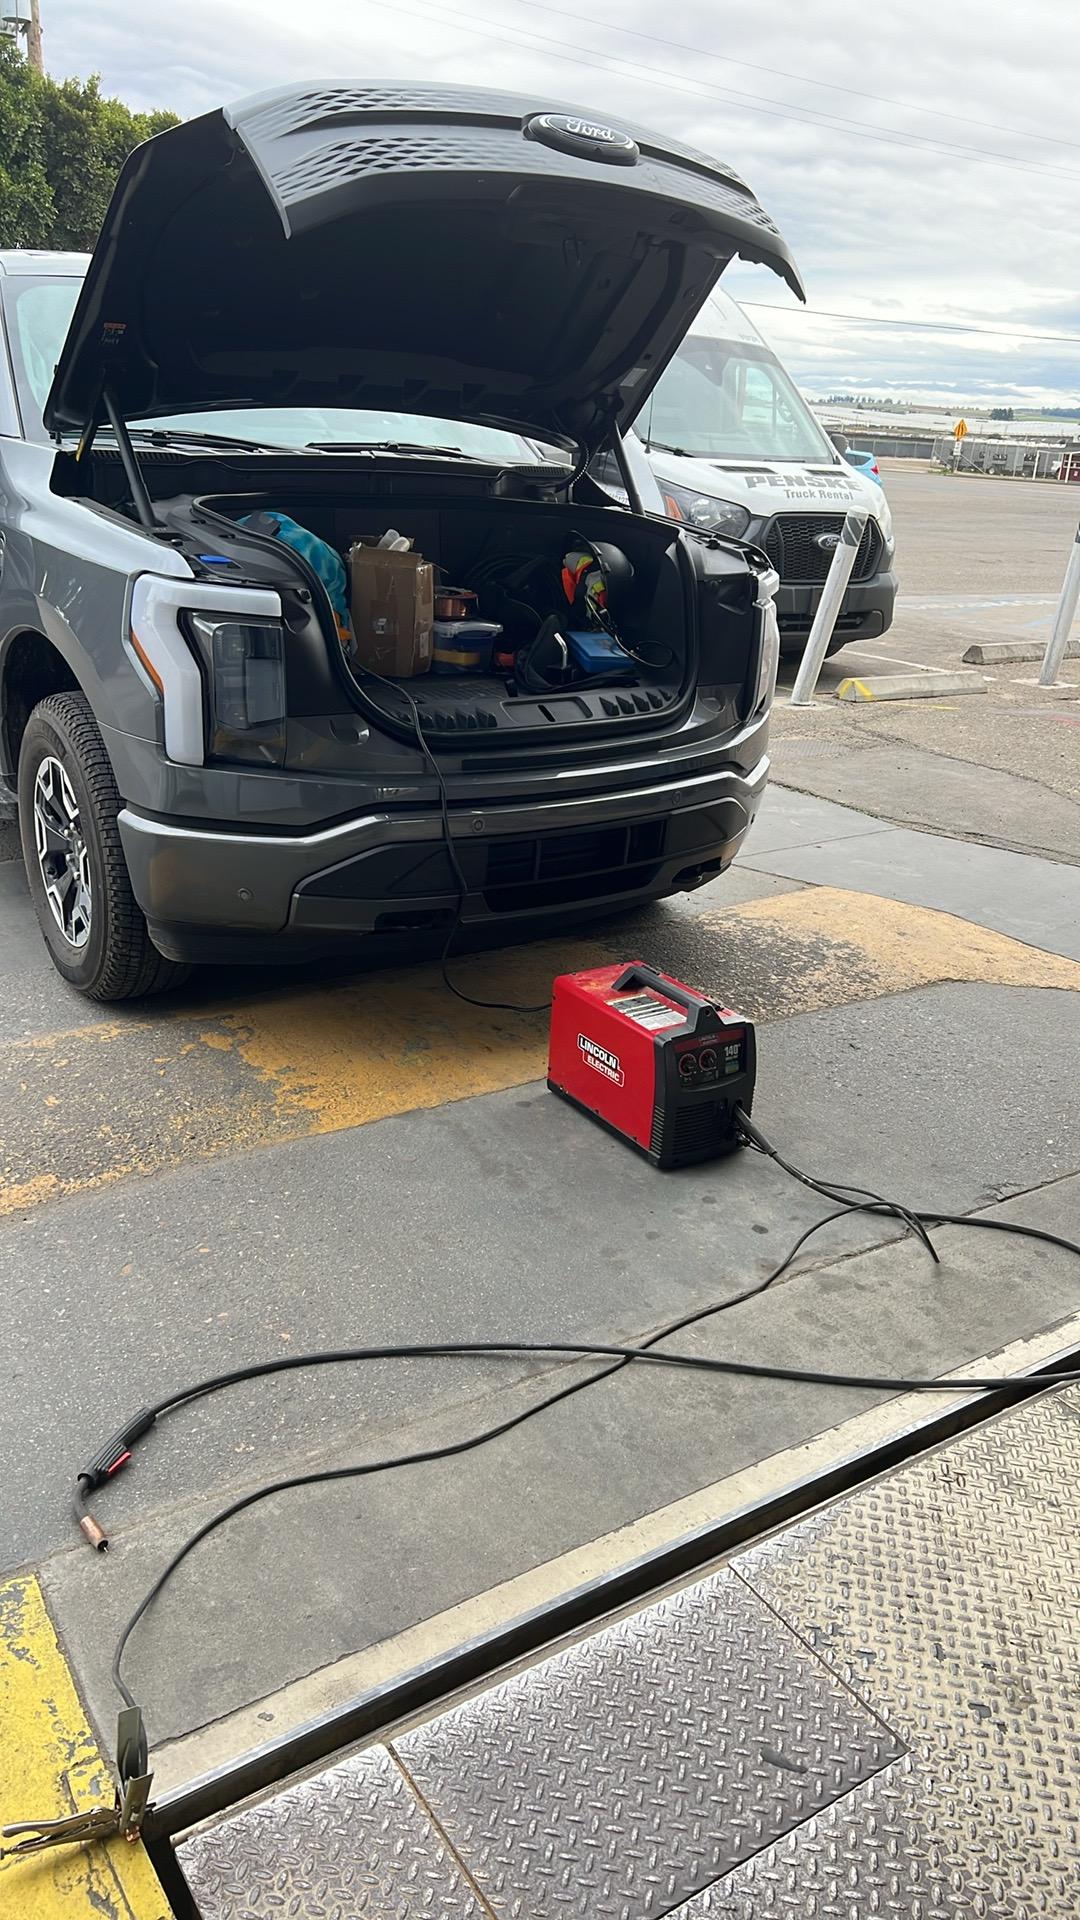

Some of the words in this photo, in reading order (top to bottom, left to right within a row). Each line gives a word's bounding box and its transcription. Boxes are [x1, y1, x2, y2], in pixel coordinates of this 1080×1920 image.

[566, 117, 615, 141] Ford
[744, 475, 863, 491] PENSKE
[783, 489, 816, 499] Truck
[818, 490, 854, 500] Rental
[580, 1037, 617, 1069] LINCOLN
[587, 1055, 620, 1081] ELECTRIC
